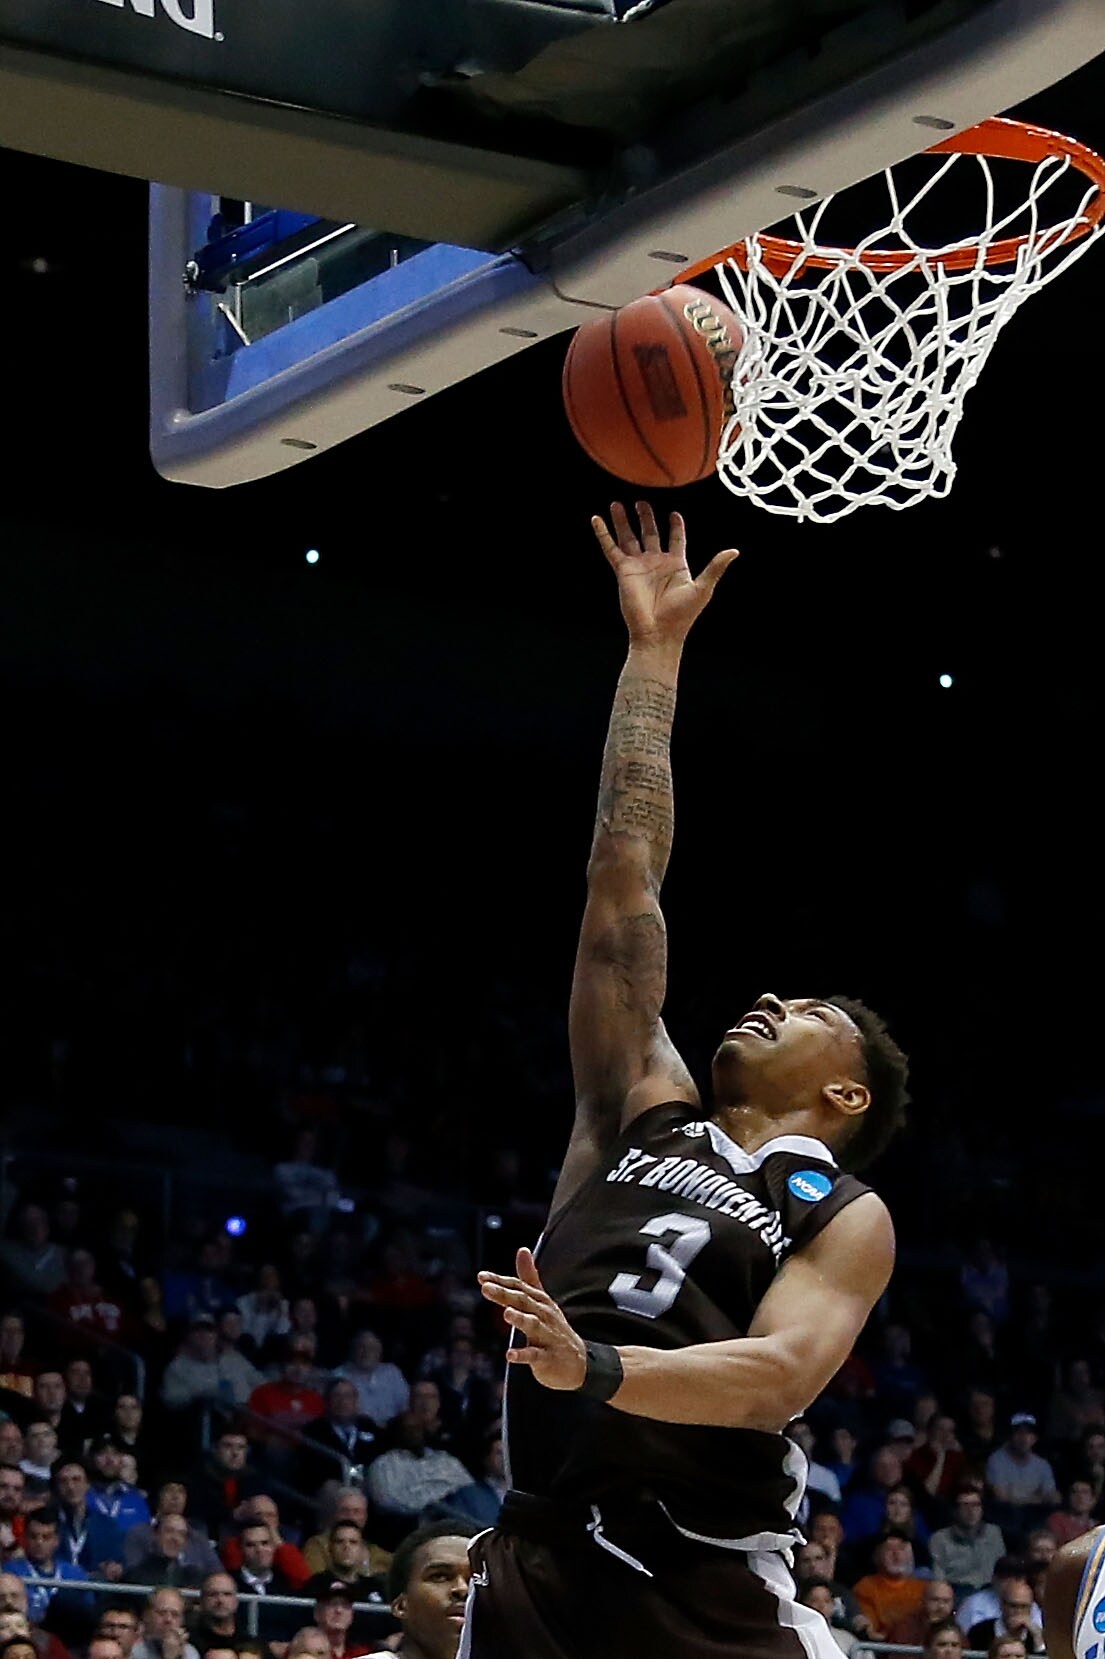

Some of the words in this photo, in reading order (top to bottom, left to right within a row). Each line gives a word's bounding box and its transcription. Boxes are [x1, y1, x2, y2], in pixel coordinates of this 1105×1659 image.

[638, 1156, 793, 1268] BONAVENTU
[791, 1177, 825, 1201] NCAA
[608, 1212, 713, 1320] 3
